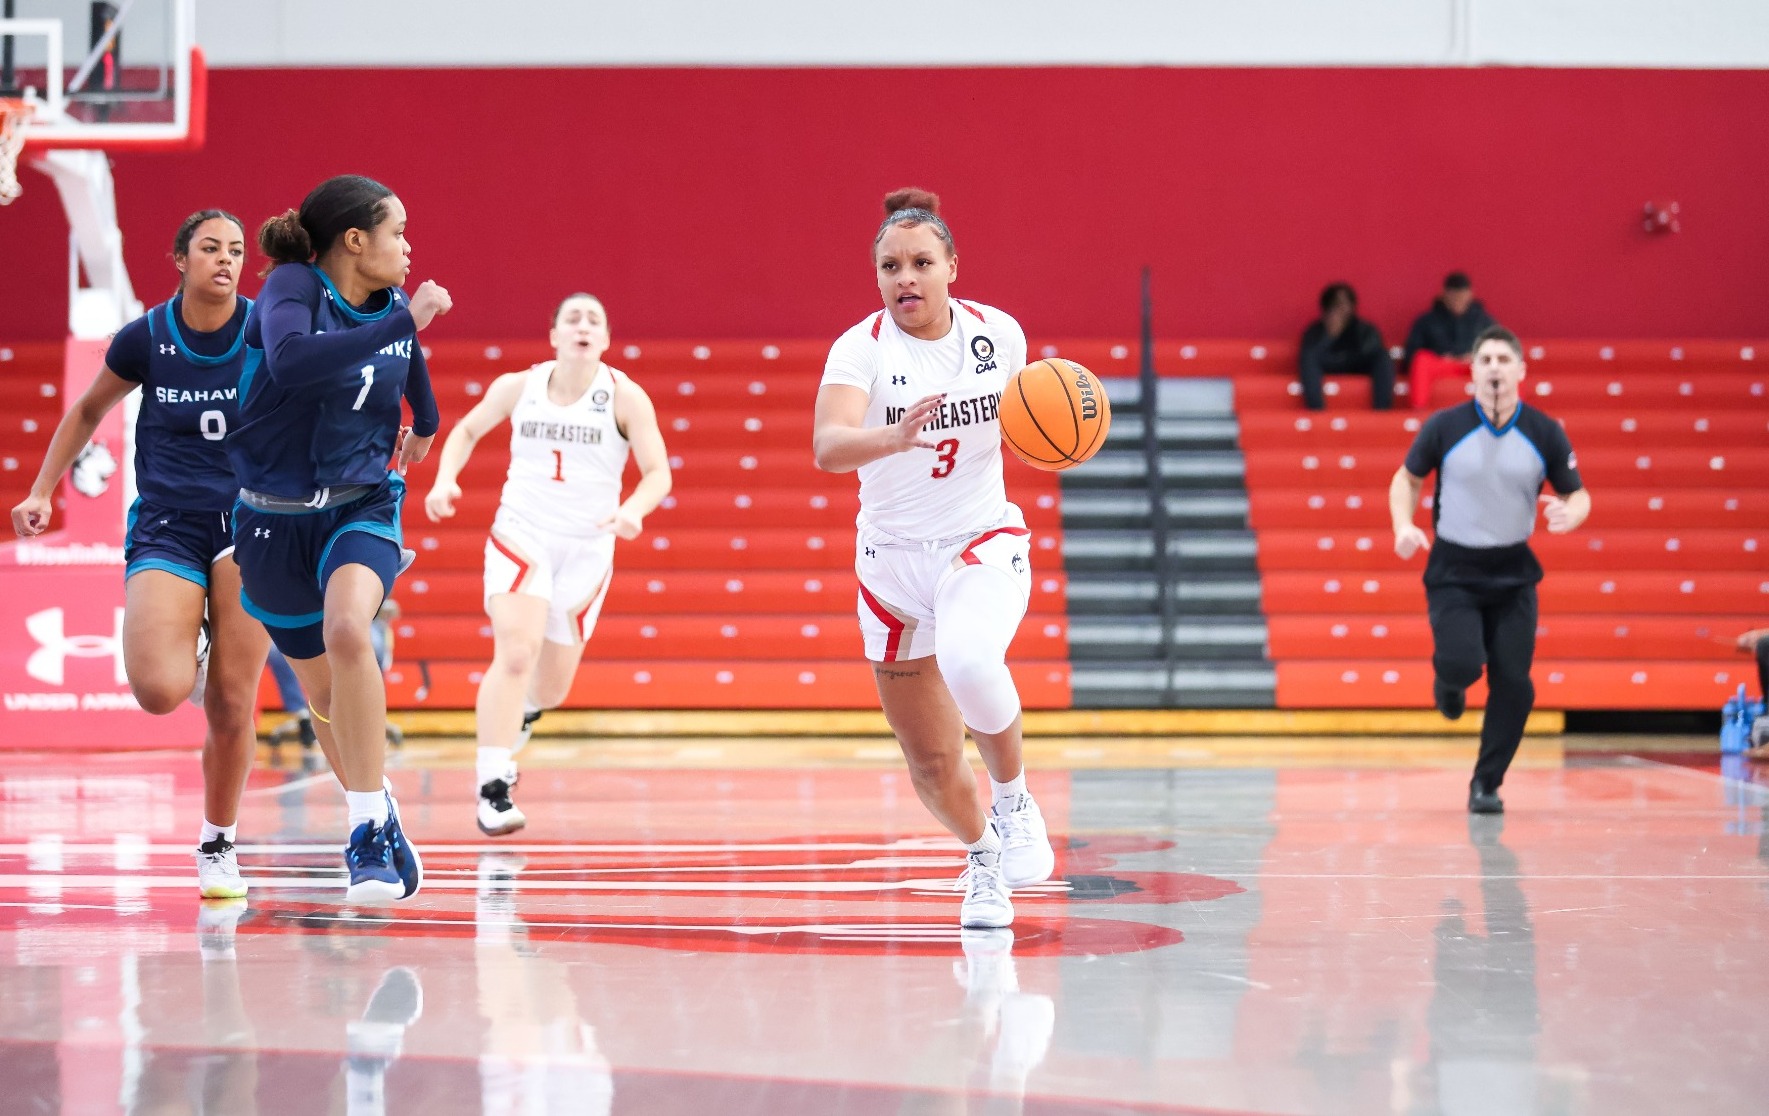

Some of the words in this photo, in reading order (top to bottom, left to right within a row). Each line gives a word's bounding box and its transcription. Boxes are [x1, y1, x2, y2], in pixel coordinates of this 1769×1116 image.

[975, 360, 997, 374] CAA
[351, 364, 375, 411] 1
[200, 410, 227, 441] 0
[520, 420, 602, 445] NORTHEASTERN
[551, 448, 565, 482] 1
[931, 438, 960, 479] 3
